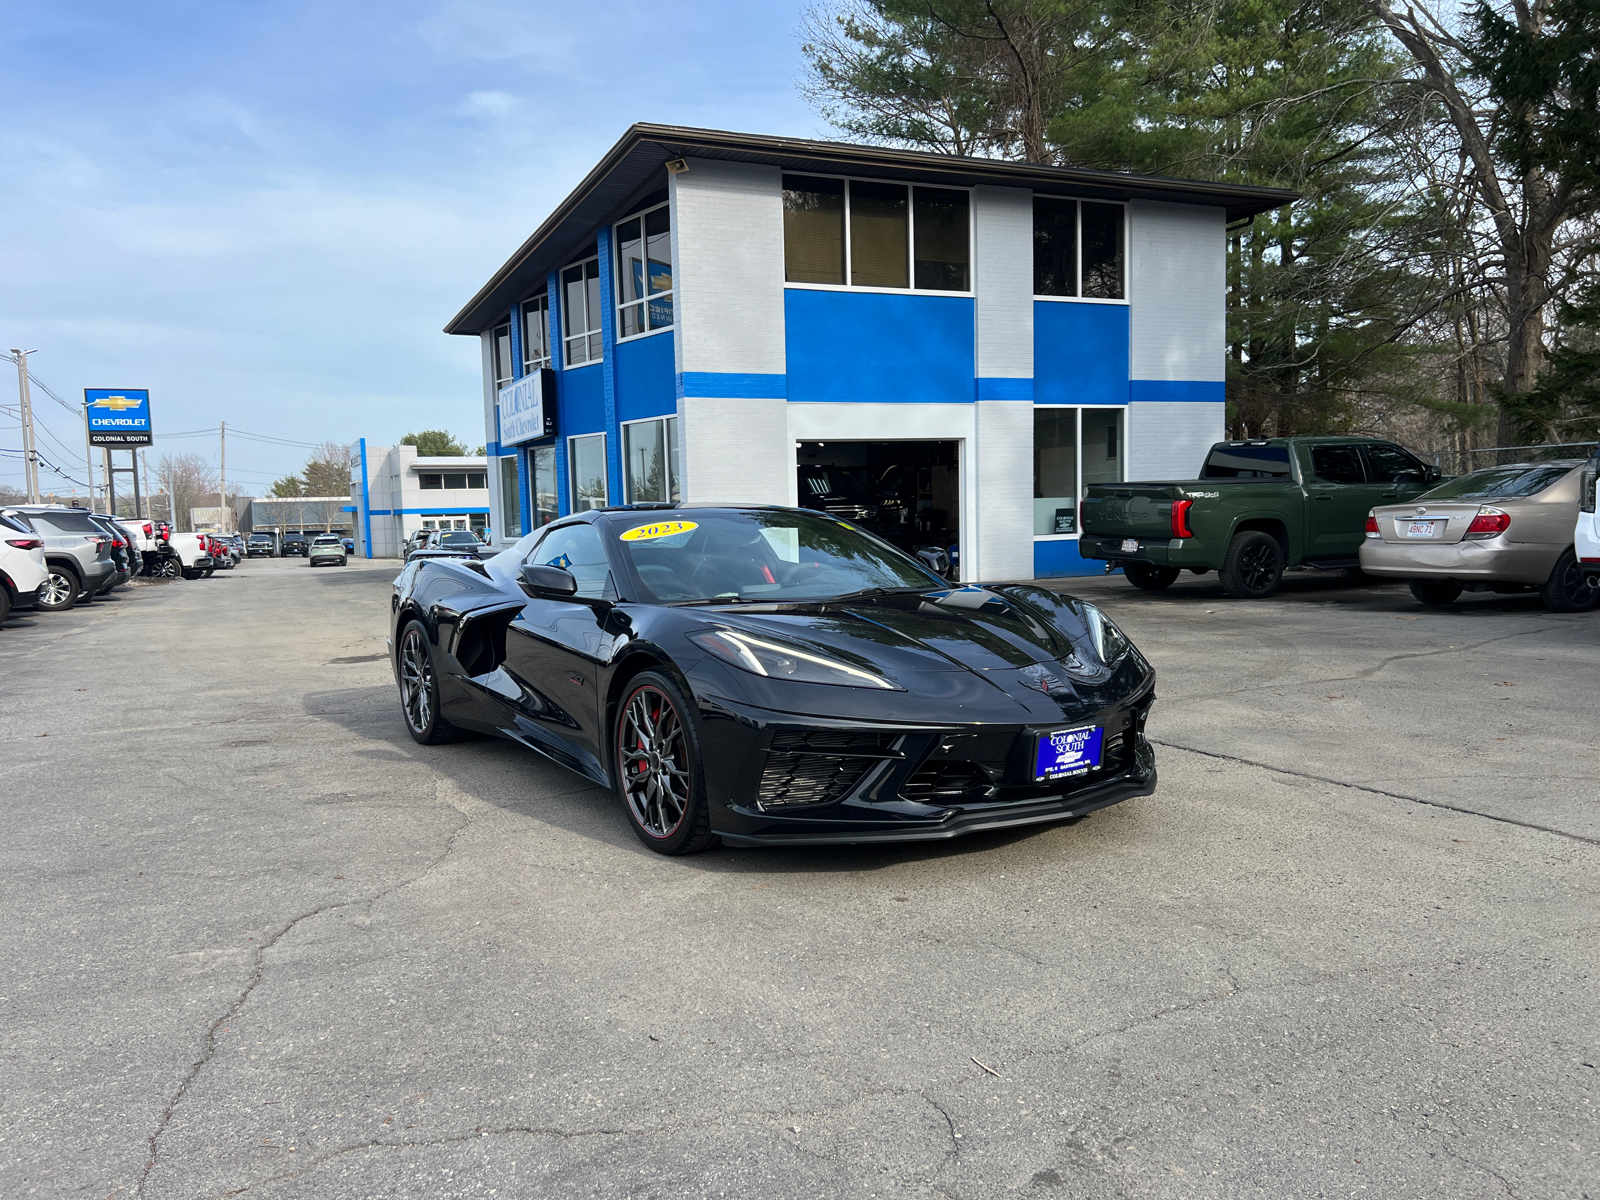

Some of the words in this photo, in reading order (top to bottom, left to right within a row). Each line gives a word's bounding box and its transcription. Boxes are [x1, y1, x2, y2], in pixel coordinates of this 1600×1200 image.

[502, 379, 538, 420] COLONIAL
[92, 418, 146, 426] CHEVROLET
[504, 420, 516, 440] South
[515, 412, 540, 437] Chevrolet
[1186, 491, 1204, 499] TRD
[1098, 511, 1149, 521] TUNDRA
[636, 522, 683, 538] 2023
[1050, 731, 1091, 746] COLONIAL
[1056, 741, 1084, 753] SOUTH
[1050, 771, 1072, 779] COLONIAL
